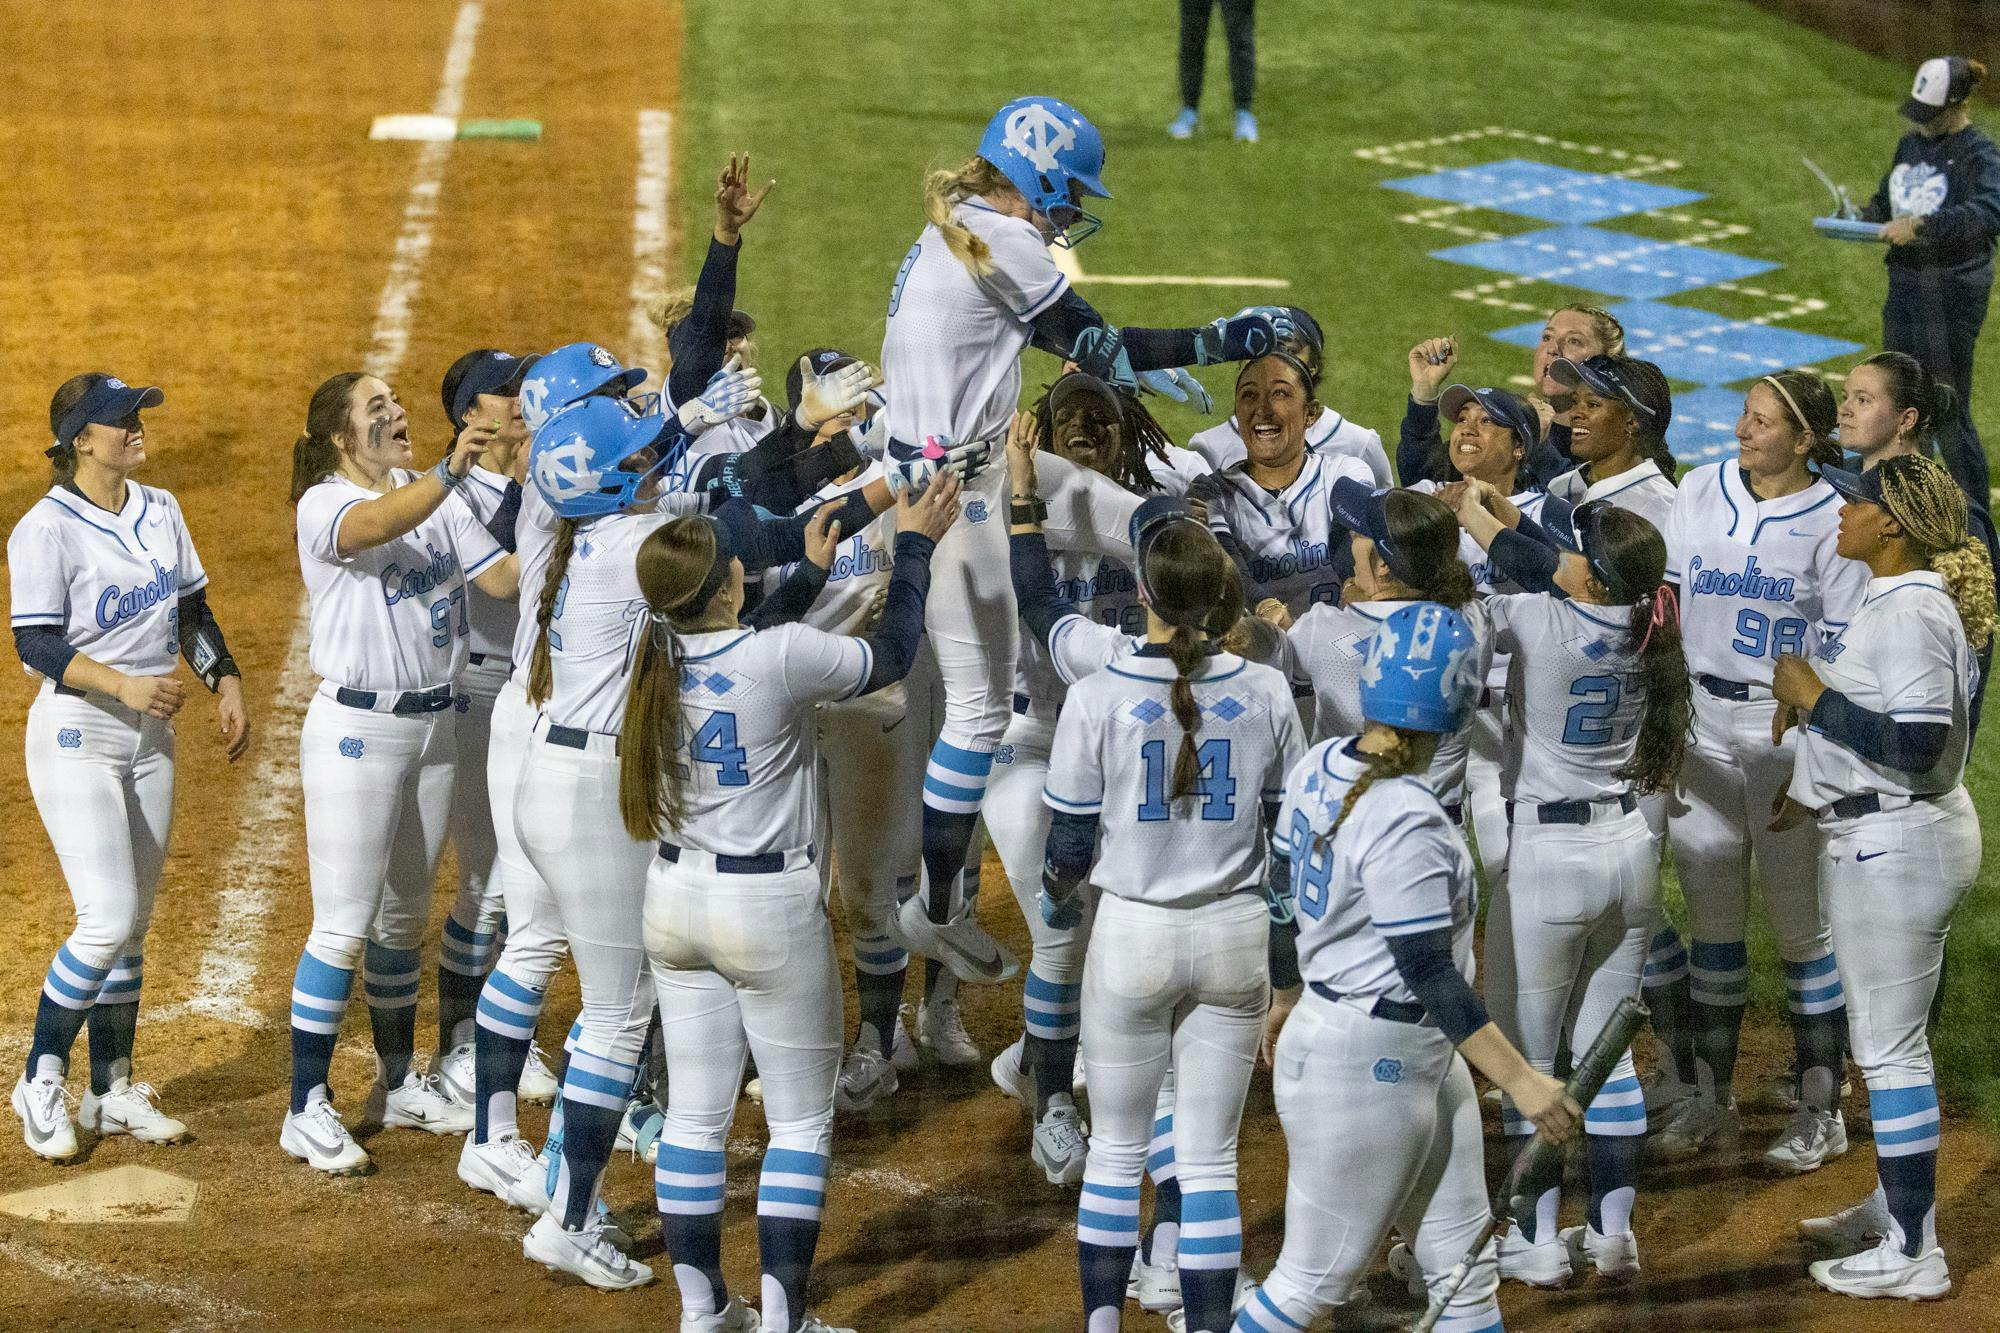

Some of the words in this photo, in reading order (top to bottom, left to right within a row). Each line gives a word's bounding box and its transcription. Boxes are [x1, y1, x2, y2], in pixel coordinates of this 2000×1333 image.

[1547, 521, 1574, 545] SOFTBALL
[1689, 545, 1795, 602] Carolina
[1732, 608, 1809, 658] 98
[1137, 738, 1237, 822] 14
[545, 1135, 564, 1156] EEL
